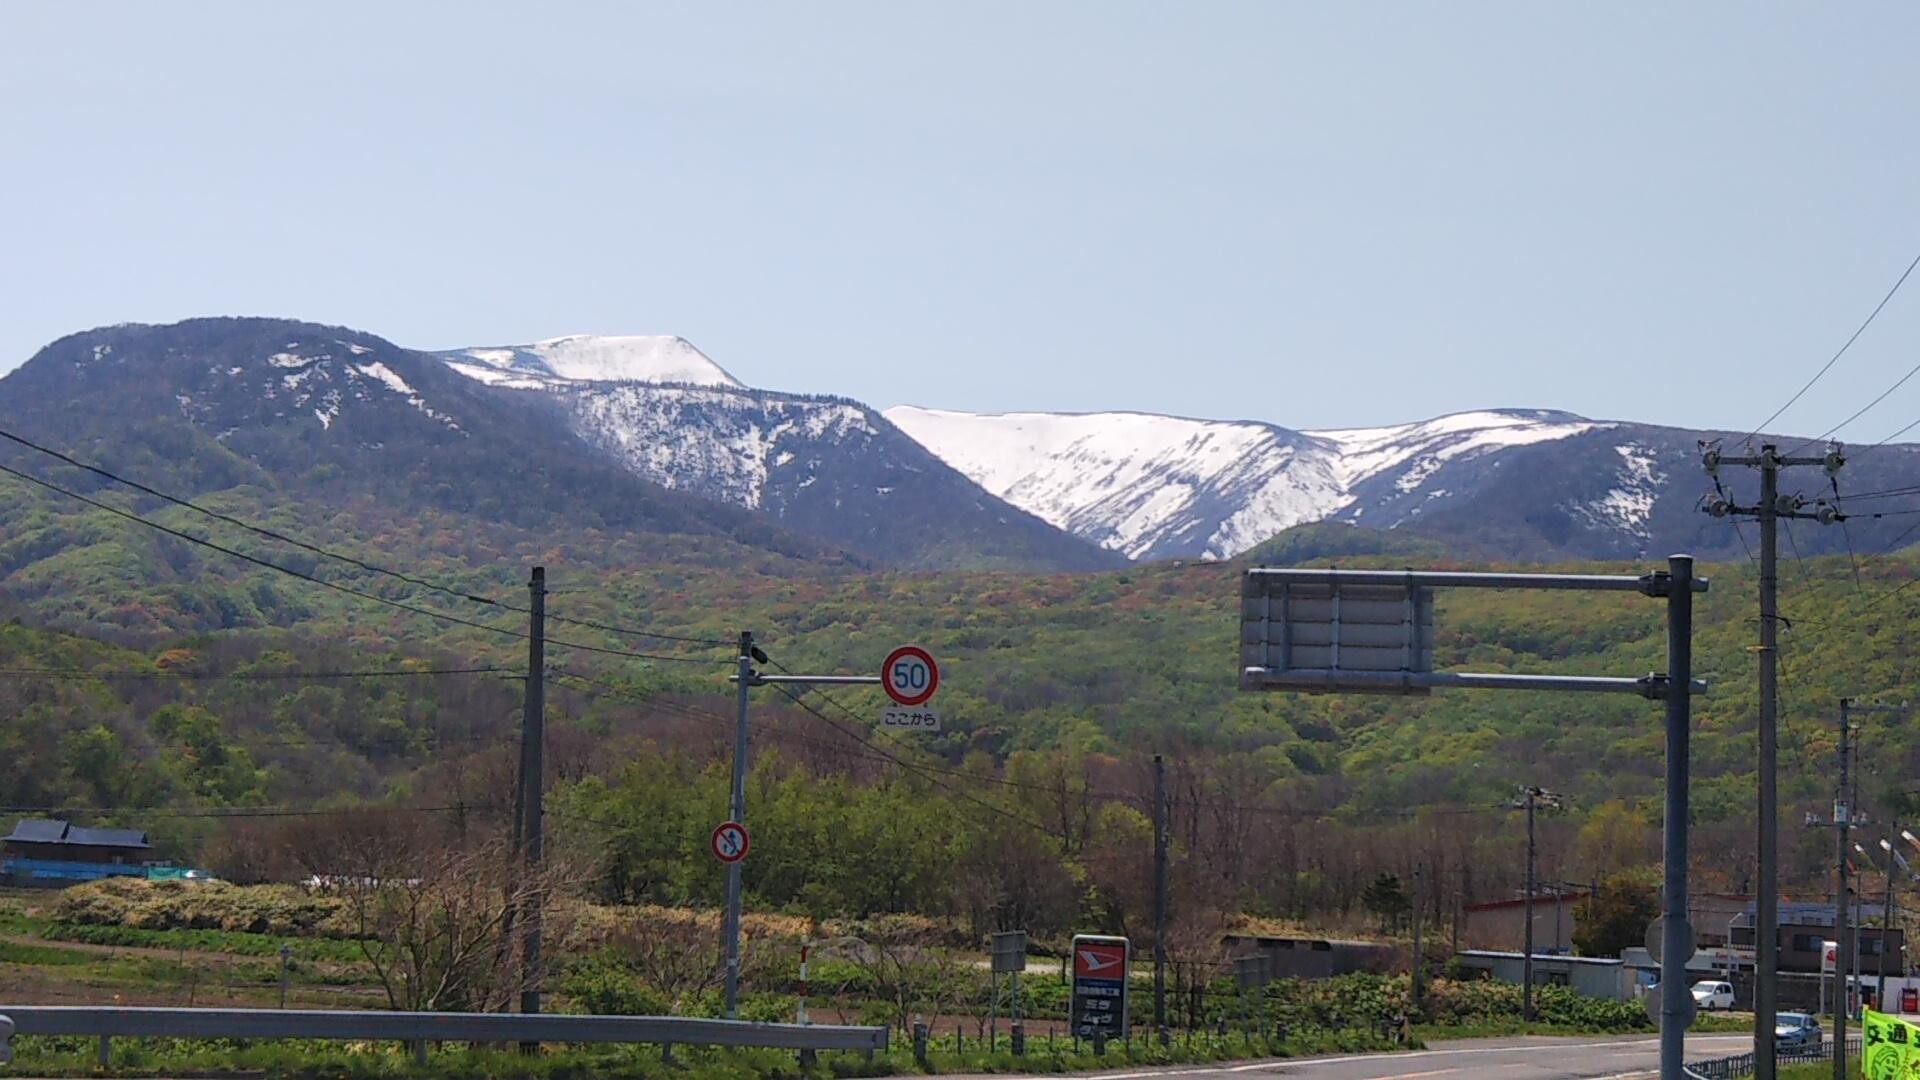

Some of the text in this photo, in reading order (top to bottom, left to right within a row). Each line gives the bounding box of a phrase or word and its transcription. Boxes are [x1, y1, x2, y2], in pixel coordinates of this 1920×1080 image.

[894, 663, 925, 689] 50
[885, 712, 936, 726] ここから
[1868, 1023, 1920, 1048] 交通
